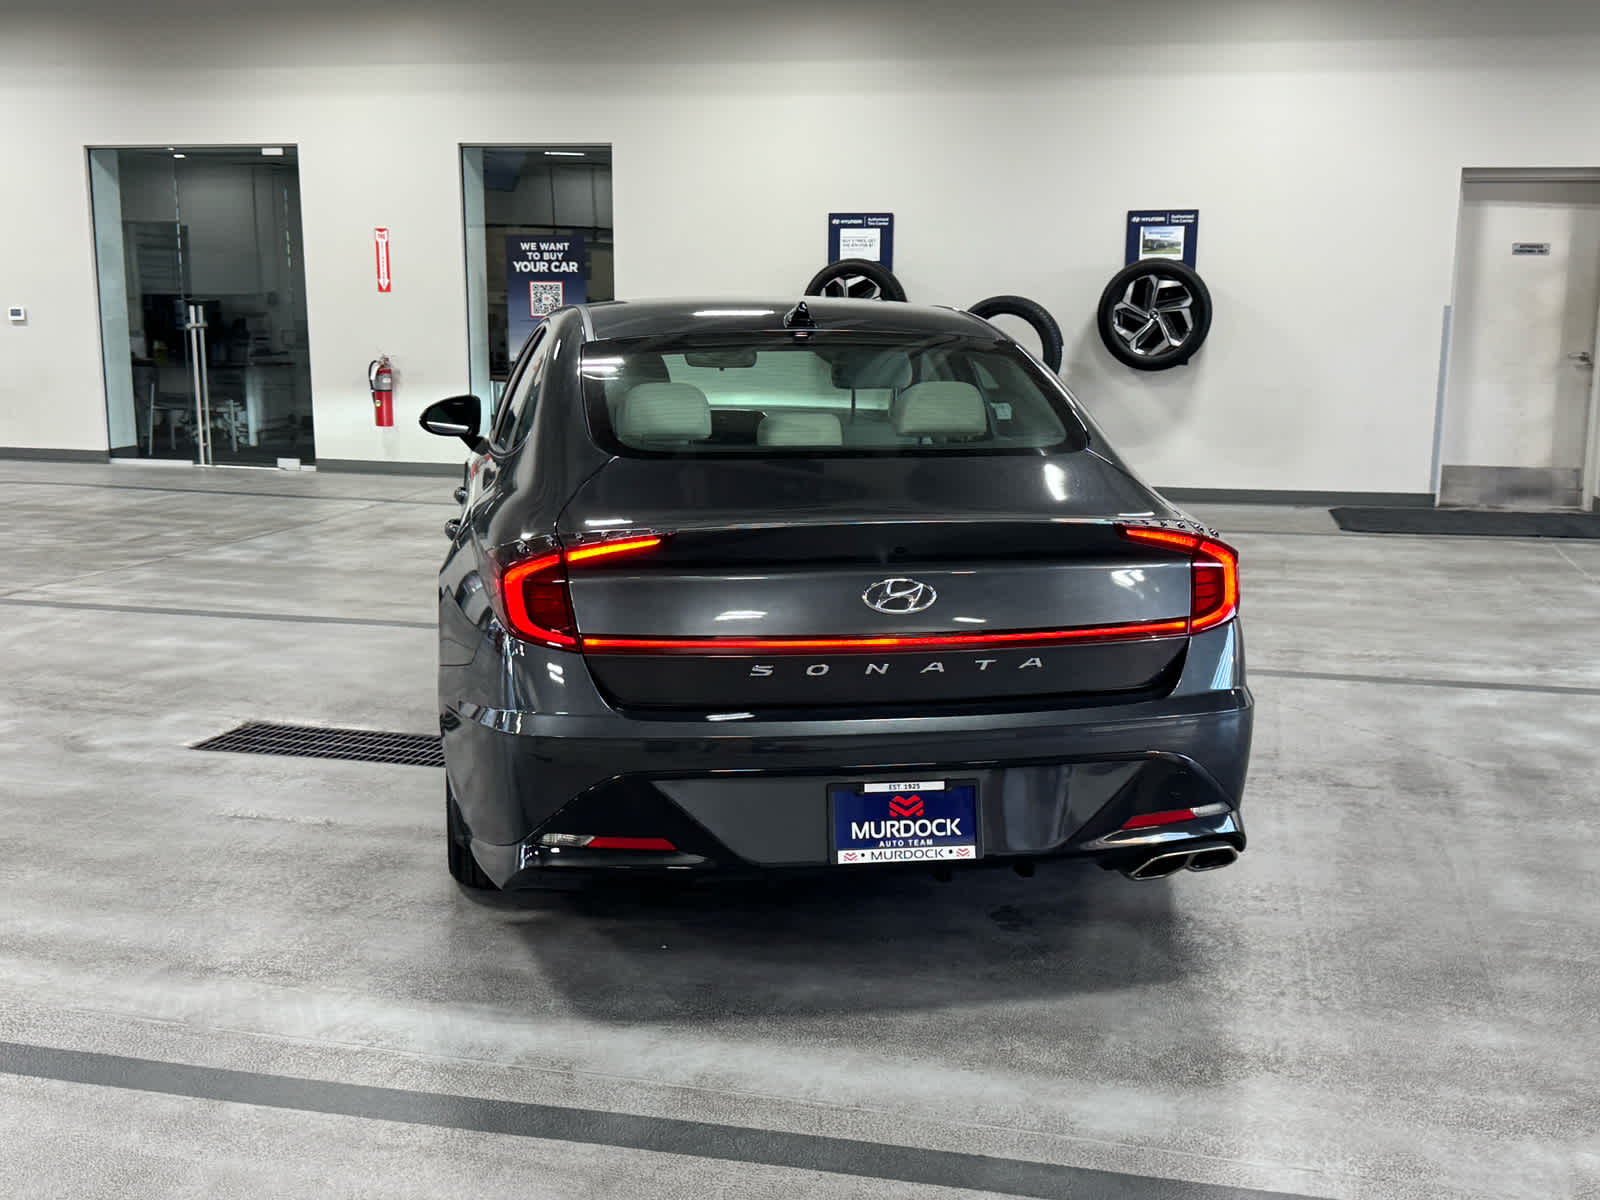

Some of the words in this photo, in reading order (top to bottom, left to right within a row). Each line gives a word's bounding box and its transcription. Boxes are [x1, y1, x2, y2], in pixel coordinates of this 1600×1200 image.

[520, 242, 537, 251] WE
[540, 242, 570, 251] WANT
[526, 252, 540, 260] TO
[543, 252, 564, 260] BUY
[513, 261, 549, 272] YOUR
[551, 261, 578, 272] CAR
[750, 657, 1044, 677] SONATA
[851, 818, 962, 840] MURDOCK
[878, 840, 904, 848] AUTO
[870, 848, 945, 860] MURDOCK
